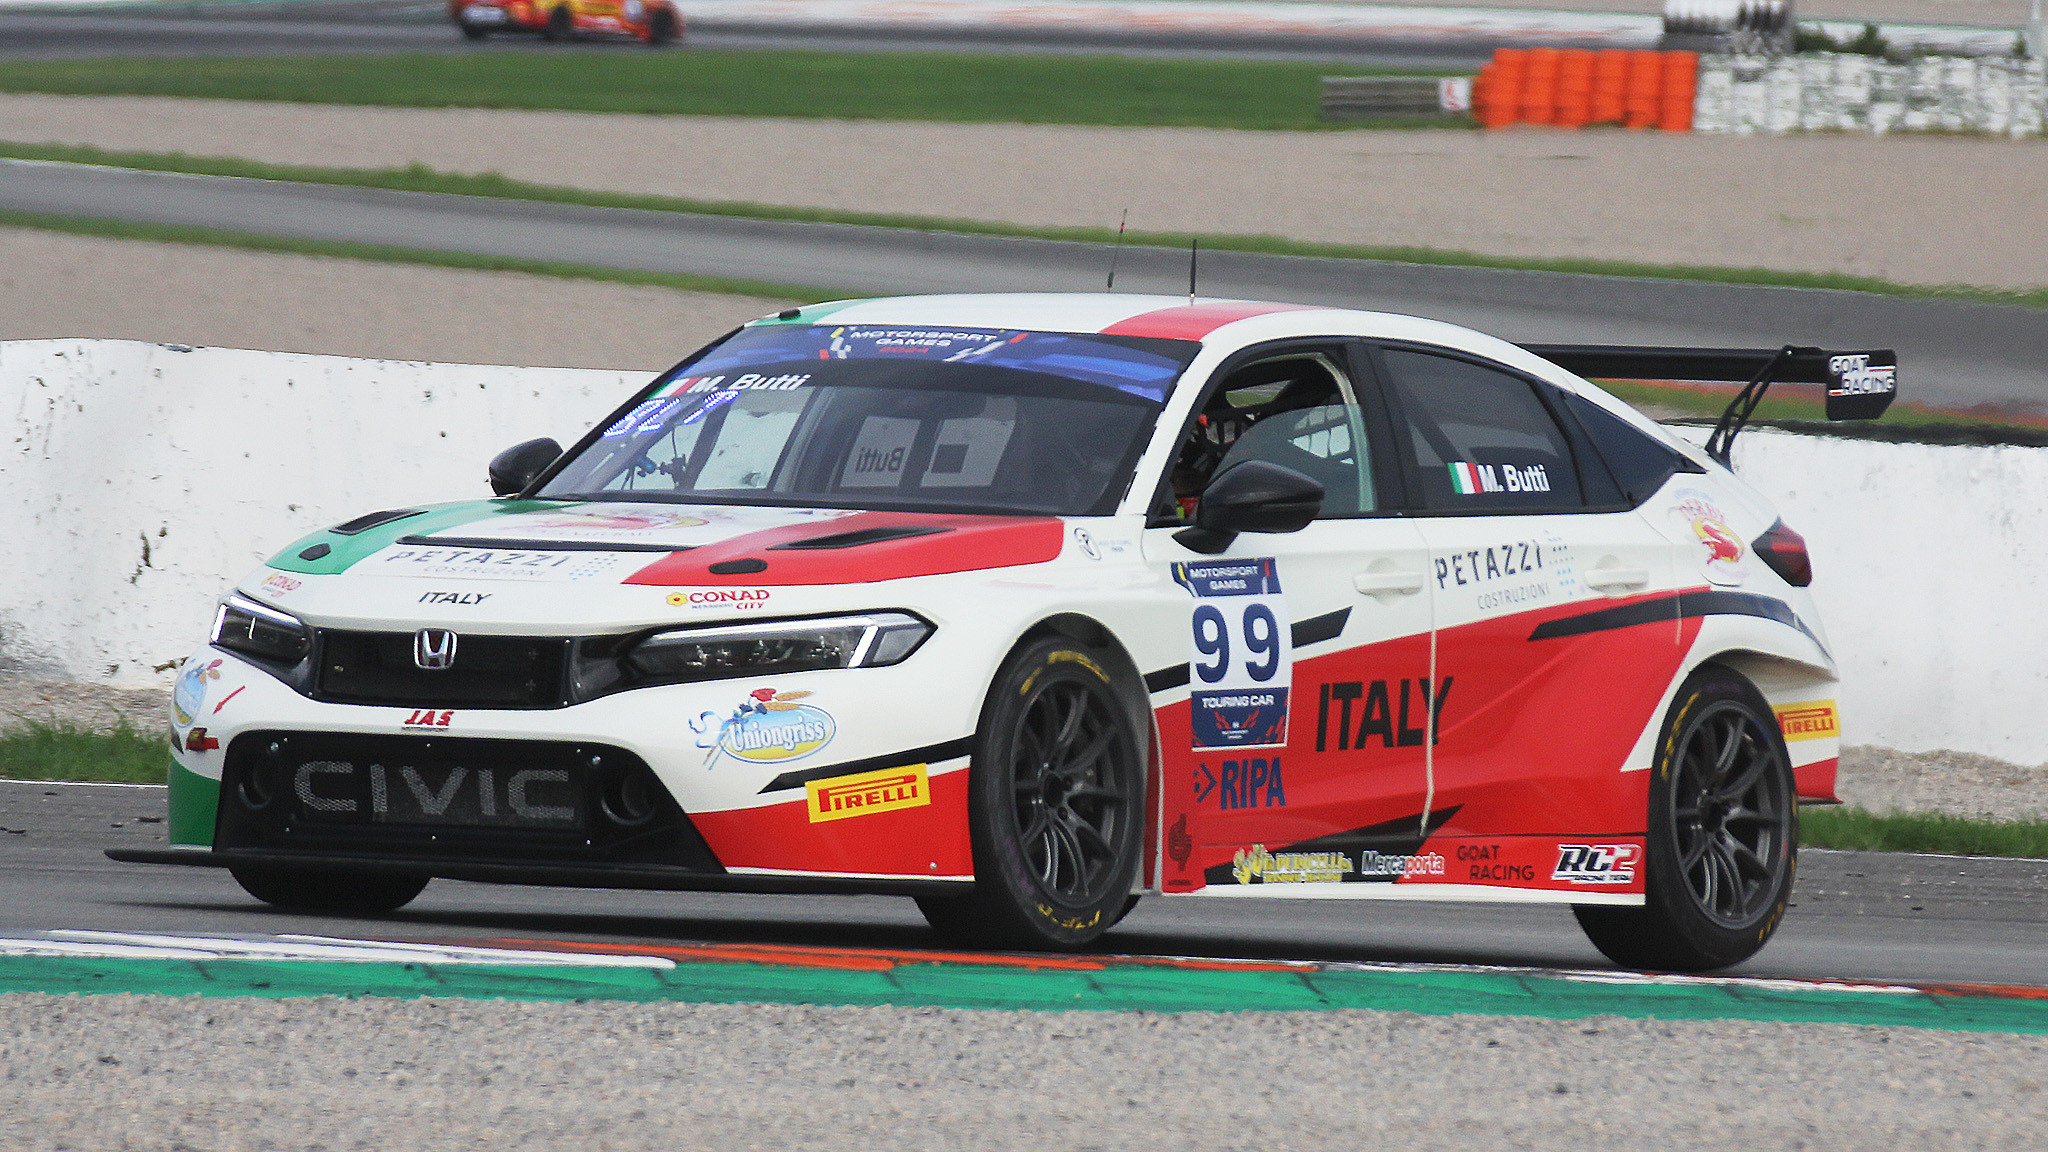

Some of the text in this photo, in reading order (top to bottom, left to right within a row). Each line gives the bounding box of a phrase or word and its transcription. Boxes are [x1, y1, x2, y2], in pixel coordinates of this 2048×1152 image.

[850, 331, 998, 342] MOTORSPORT
[875, 338, 952, 346] GAMES
[1830, 356, 1868, 374] GOAT
[687, 374, 812, 393] M. Butti
[1842, 376, 1896, 394] RACING
[1477, 464, 1552, 493] M. Butti
[385, 550, 571, 568] PETAZZI
[1434, 539, 1542, 590] PETAZZI
[1189, 566, 1259, 579] MOTORSPORT
[1208, 579, 1248, 590] GAMES
[417, 591, 494, 606] ITALY
[689, 589, 770, 604] CONAD
[1477, 582, 1551, 610] COSTRUZIONI
[736, 602, 765, 610] CITY
[1192, 603, 1279, 684] 99
[1202, 694, 1275, 709] TOURING CAR
[403, 710, 455, 727] JAS
[1315, 675, 1455, 752] ITALY
[1777, 707, 1835, 735] PIRELLI
[728, 721, 826, 752] Uniongriss
[294, 760, 575, 820] CIVIC
[1220, 756, 1287, 811] RIPA
[817, 774, 919, 813] PIRELLI
[1456, 844, 1502, 861] GOAT
[1556, 843, 1643, 872] RC2
[1362, 850, 1446, 879] Mercaporta
[1469, 864, 1535, 881] RACING
